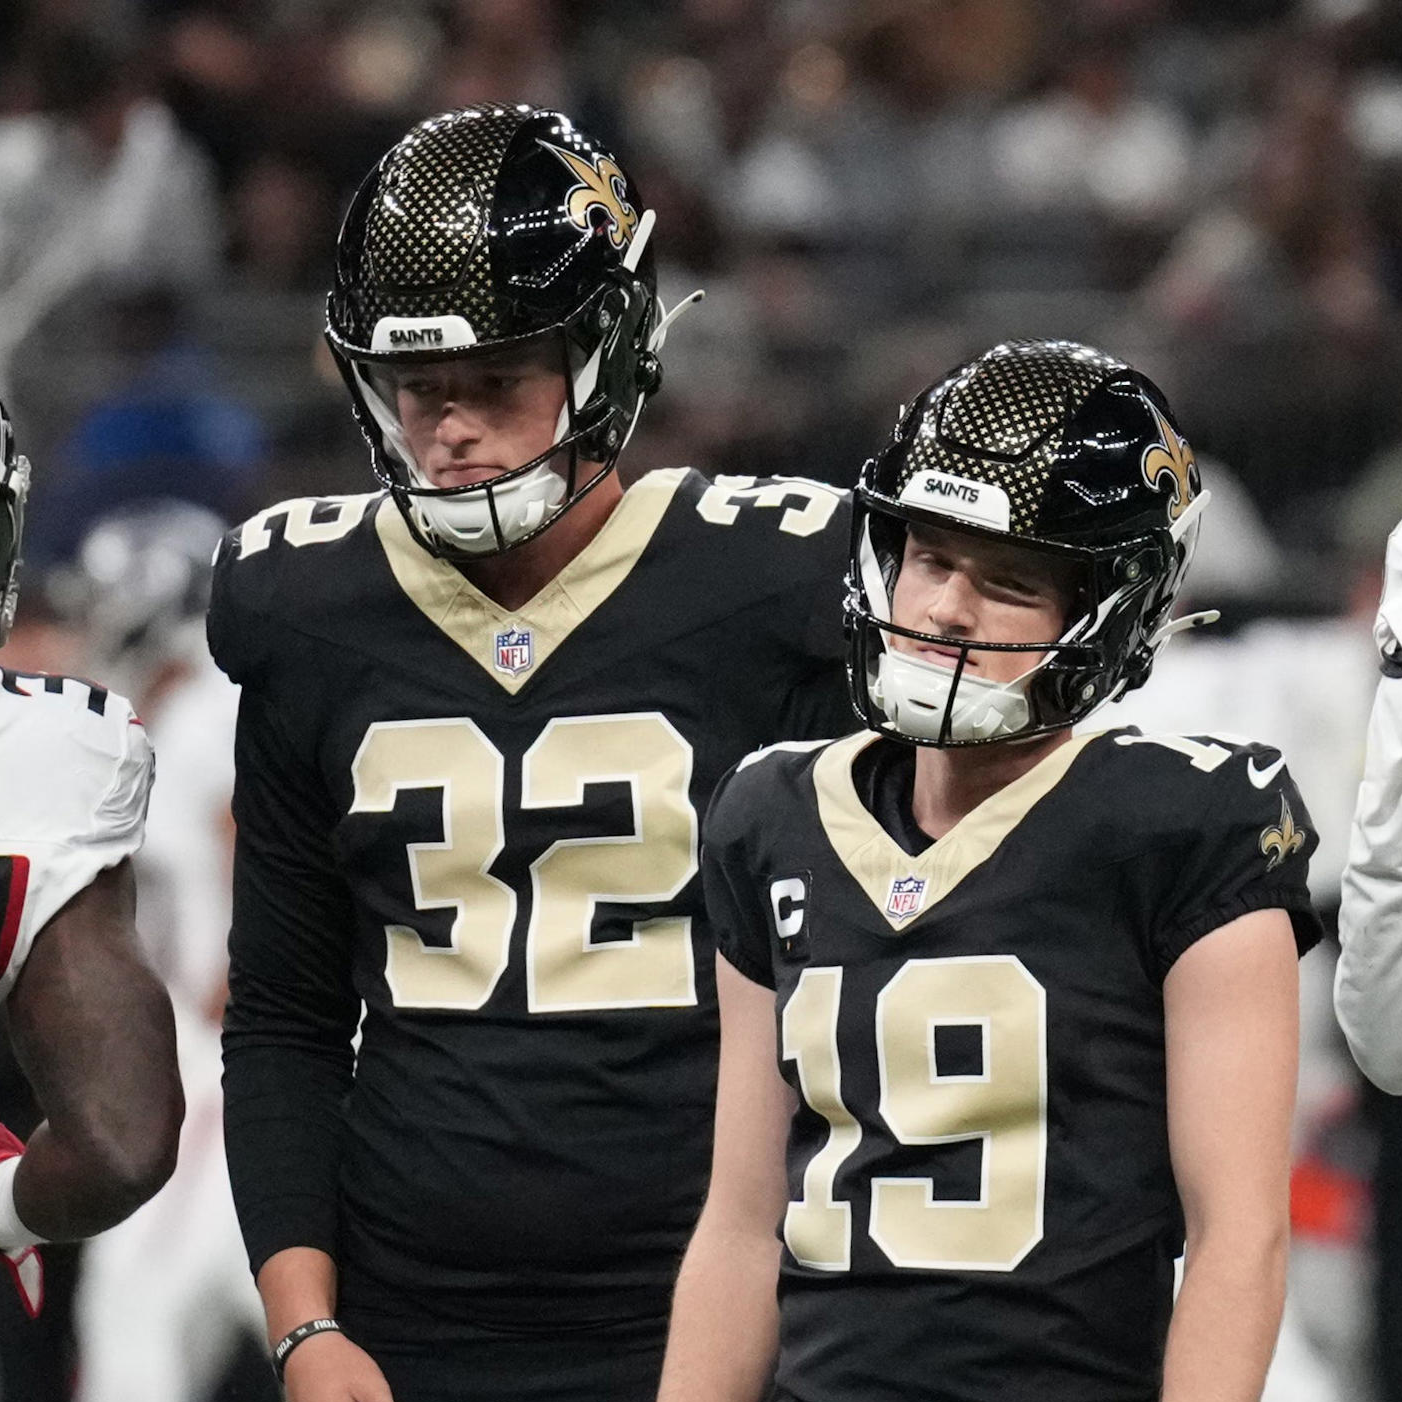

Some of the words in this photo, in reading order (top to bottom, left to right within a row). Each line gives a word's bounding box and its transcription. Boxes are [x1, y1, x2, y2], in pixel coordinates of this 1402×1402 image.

[390, 327, 443, 344] SAINTS
[924, 478, 980, 503] SAINTS
[500, 648, 527, 667] NFL
[348, 711, 699, 1014] 32
[770, 877, 806, 939] C
[891, 892, 918, 914] NFL
[782, 954, 1048, 1272] 19
